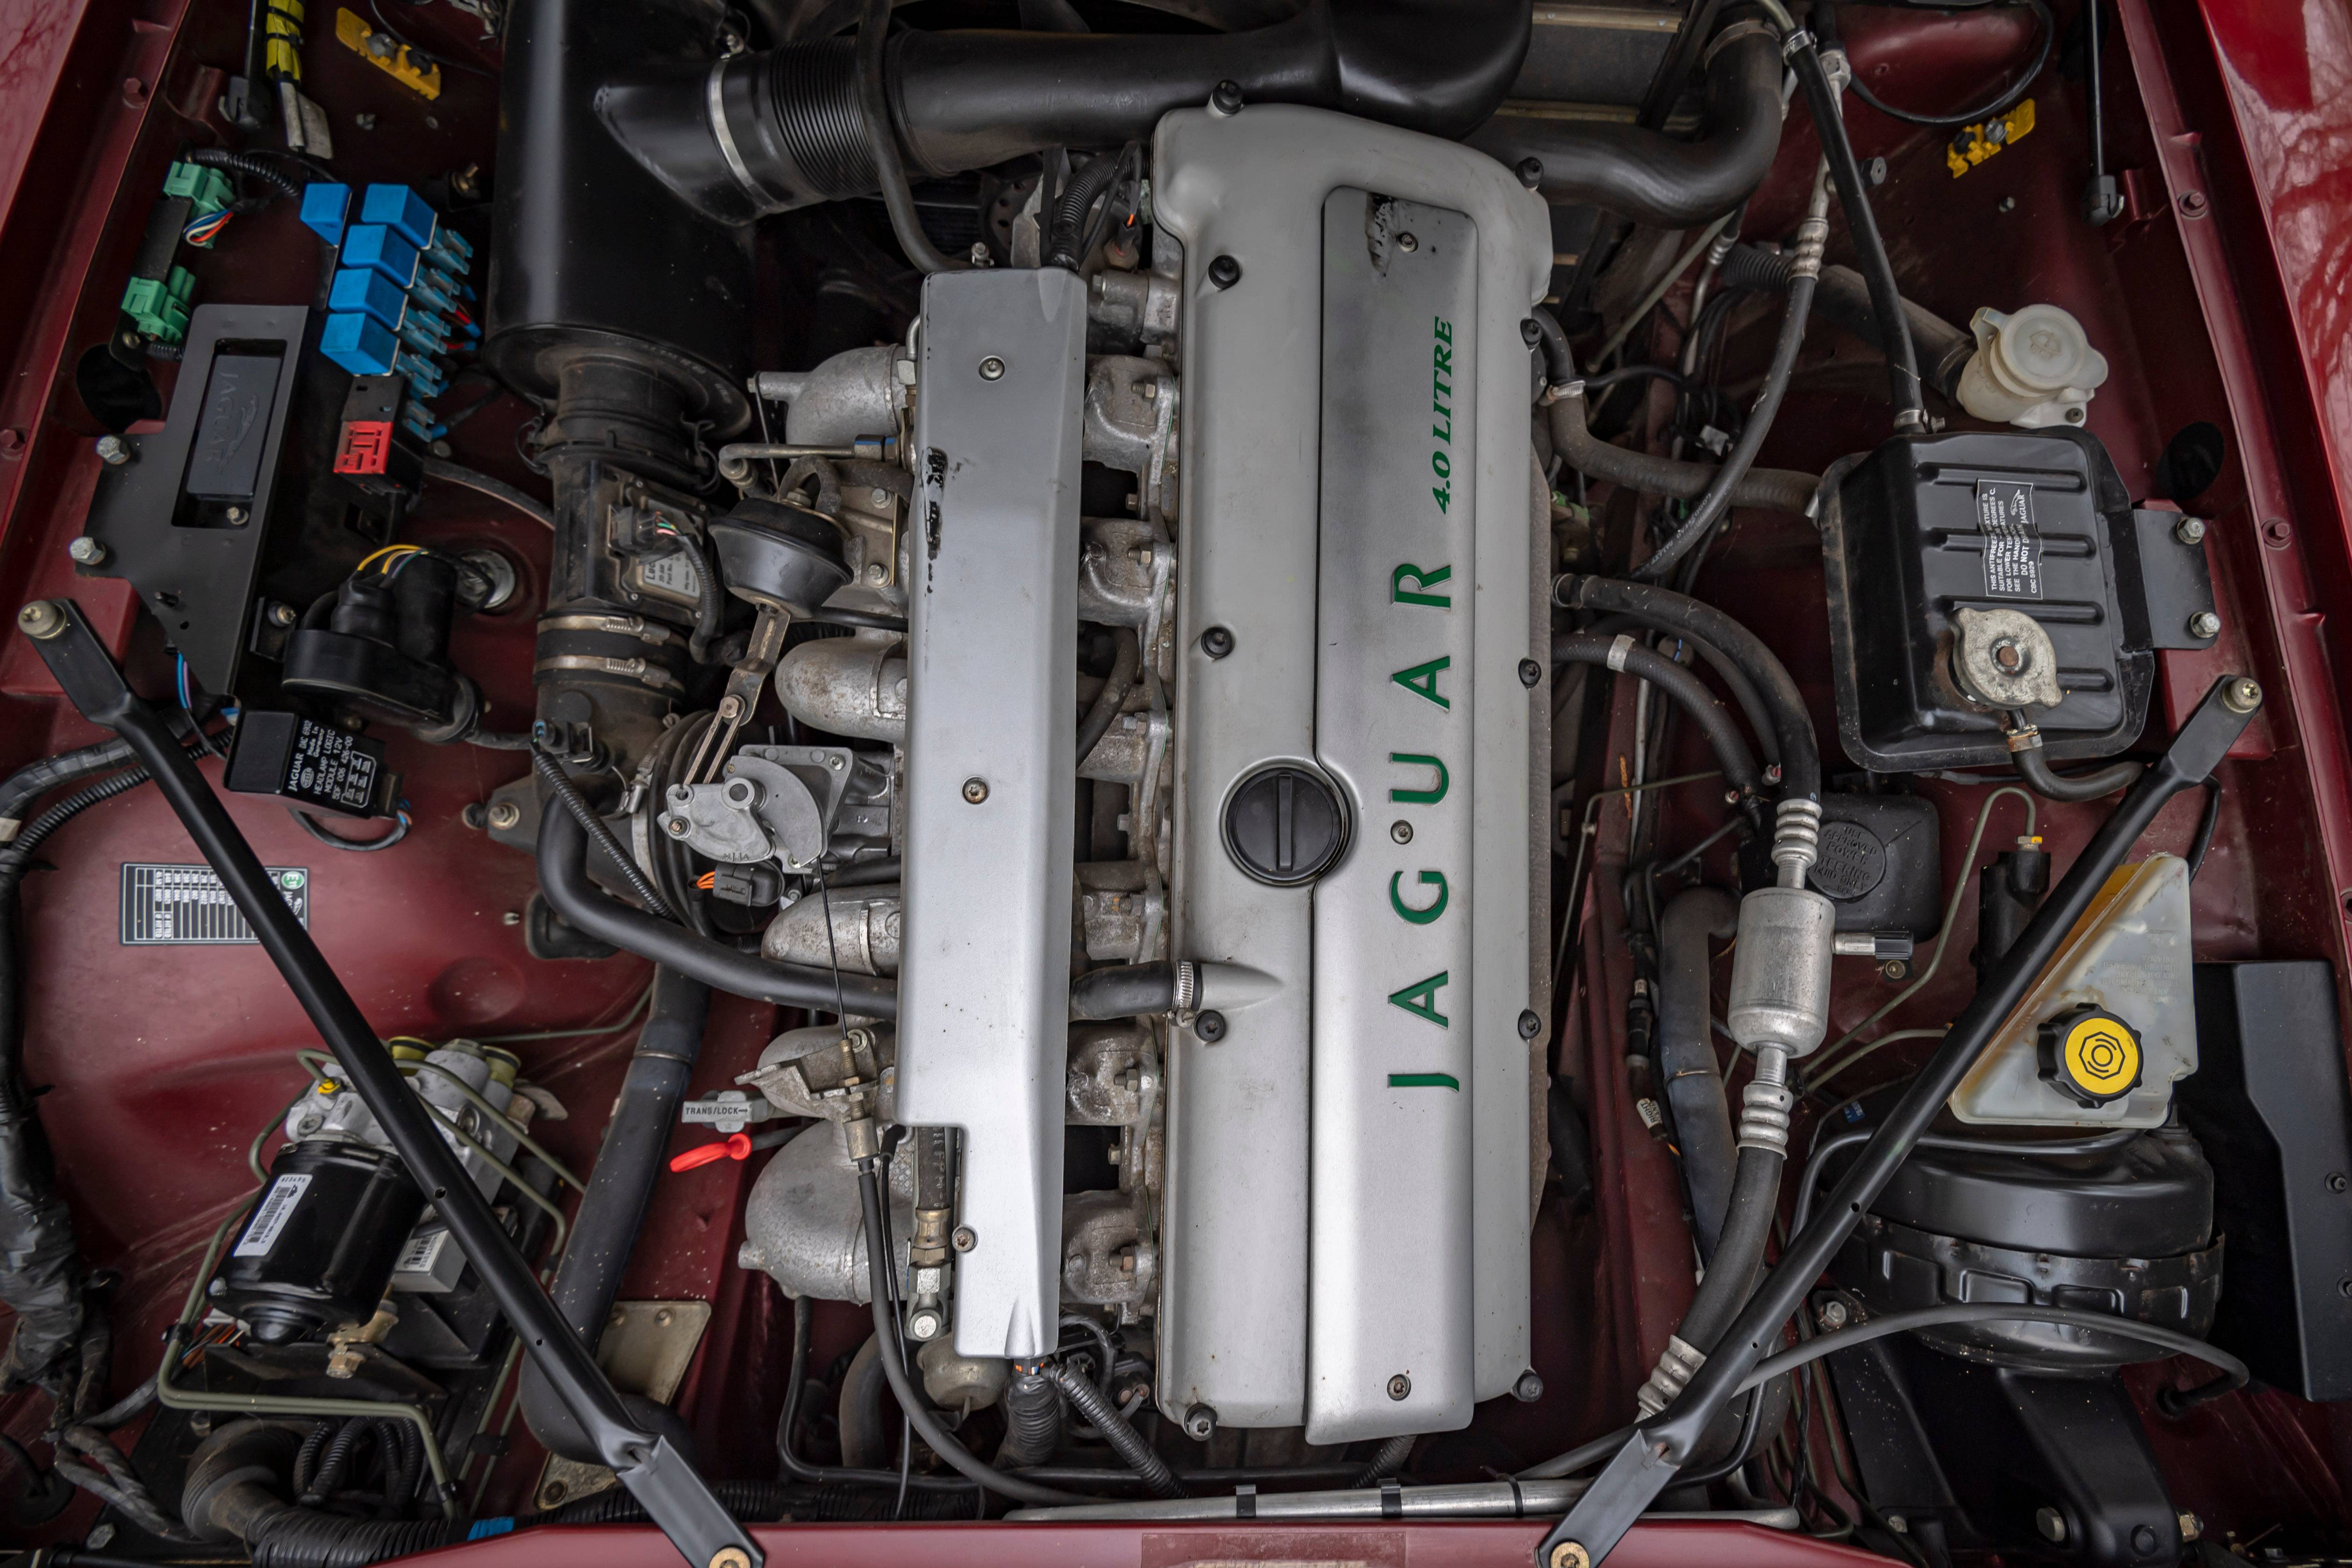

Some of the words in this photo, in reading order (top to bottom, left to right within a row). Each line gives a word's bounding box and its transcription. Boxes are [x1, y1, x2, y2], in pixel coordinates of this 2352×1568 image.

[1433, 315, 1452, 446] LITRE
[206, 372, 240, 461] JAGUAR
[1983, 501, 1992, 531] MIXTURE
[2018, 494, 2029, 524] JAGUAR
[1998, 501, 2013, 549] TEMPERATURES
[2016, 524, 2030, 544] DRAIN
[1989, 531, 1997, 574] ANTIFREEZE
[2020, 546, 2029, 562] NOT
[1996, 558, 2005, 591] SUITABLE
[2021, 563, 2028, 575] DO
[307, 738, 316, 756] Made
[313, 728, 325, 757] Germany
[341, 736, 353, 764] 426-00
[288, 753, 304, 792] JAGUAR
[299, 737, 308, 749] DAC
[314, 756, 328, 795] HEADLAMP
[323, 730, 335, 754] LOGIC
[324, 759, 338, 793] MODULE
[334, 737, 343, 754] 12V
[337, 767, 346, 782] 006
[332, 785, 341, 800] 5DF
[1387, 564, 1459, 1093] JAGUAR
[1824, 830, 1877, 855] APPROVED
[1826, 842, 1869, 865] POWER
[1821, 855, 1870, 881] TEERING
[1840, 874, 1868, 891] ONLY
[1640, 1103, 1657, 1123] RIGHT
